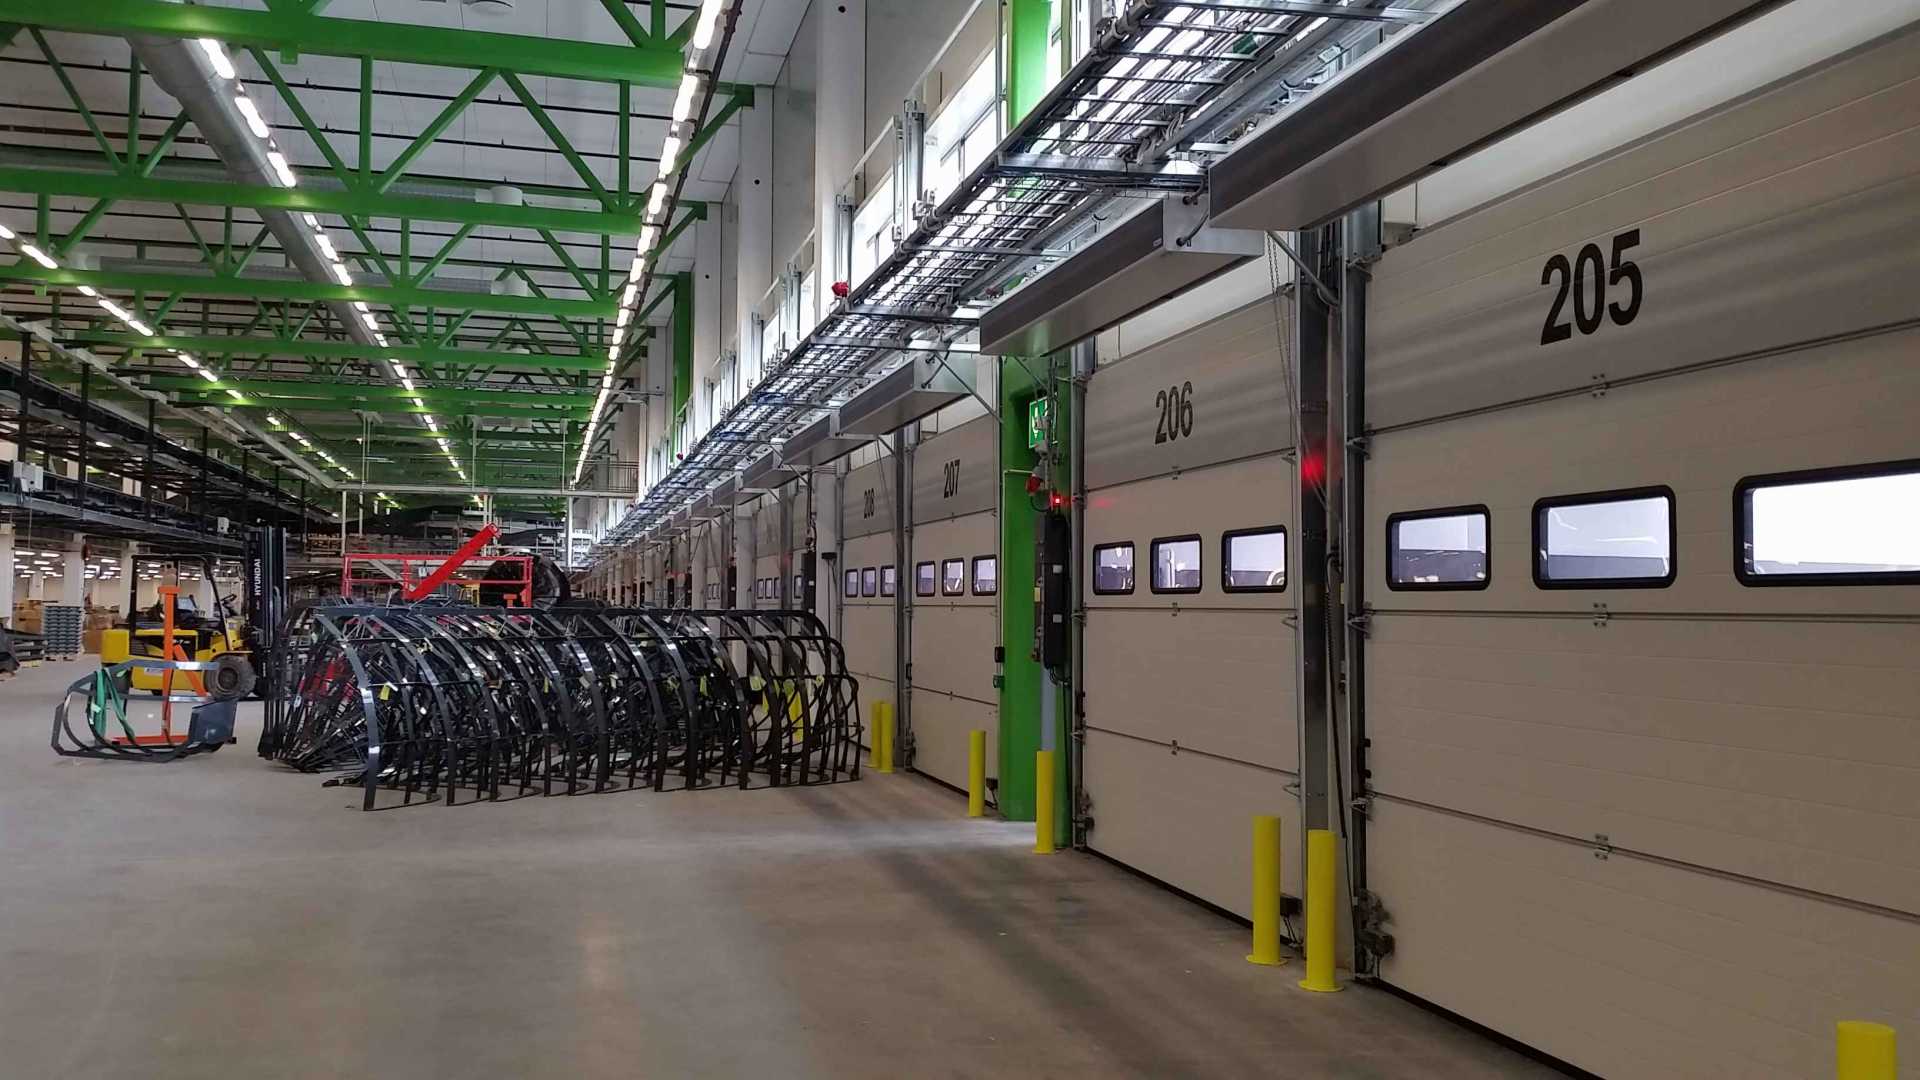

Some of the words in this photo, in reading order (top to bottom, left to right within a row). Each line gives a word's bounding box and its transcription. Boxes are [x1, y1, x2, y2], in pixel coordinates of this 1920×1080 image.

[1540, 227, 1643, 346] 205
[1155, 381, 1193, 444] 206
[943, 459, 961, 499] 207
